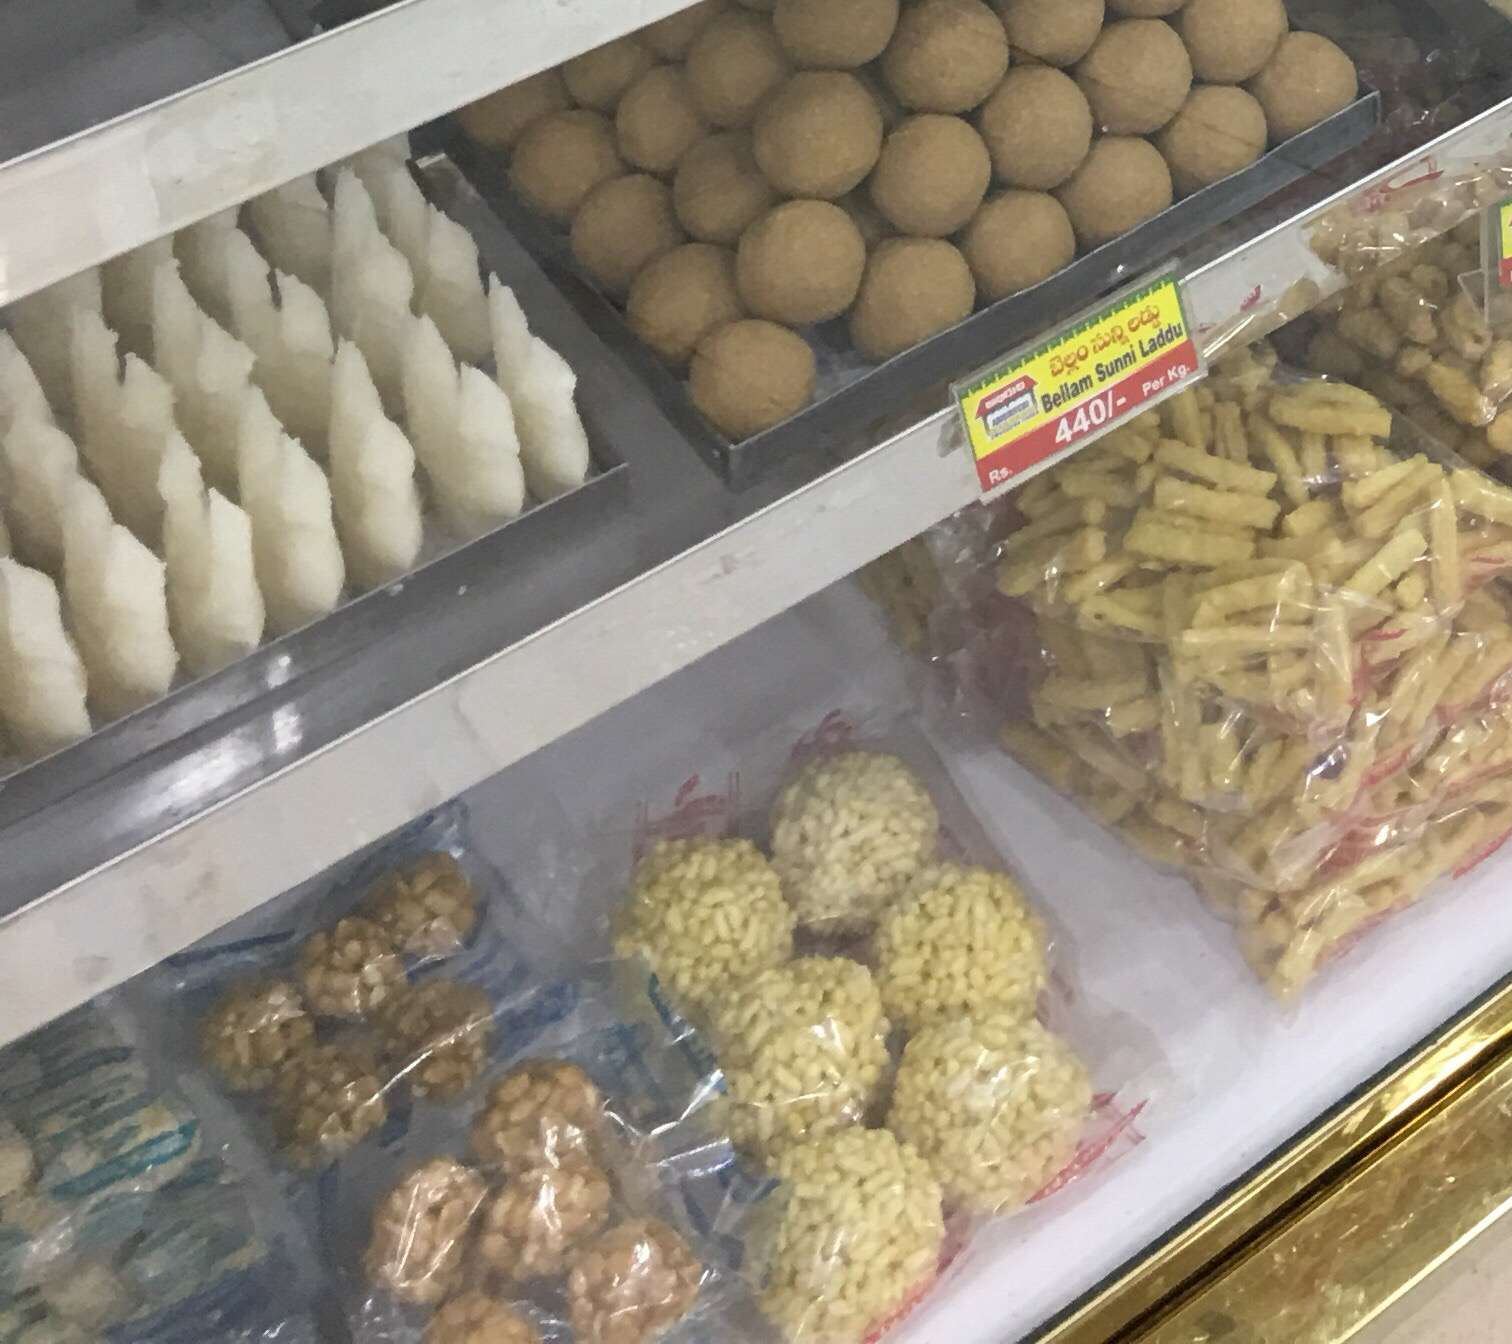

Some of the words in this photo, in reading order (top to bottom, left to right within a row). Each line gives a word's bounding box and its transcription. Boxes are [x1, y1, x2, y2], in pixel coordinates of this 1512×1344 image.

[1041, 374, 1093, 413] Bellam
[1095, 343, 1137, 382] Sunni
[1139, 322, 1184, 357] Laddu
[989, 469, 1012, 484] Rs.
[1055, 391, 1126, 443] 440/-
[1142, 377, 1166, 396] Per
[1168, 364, 1190, 381] Kg.
